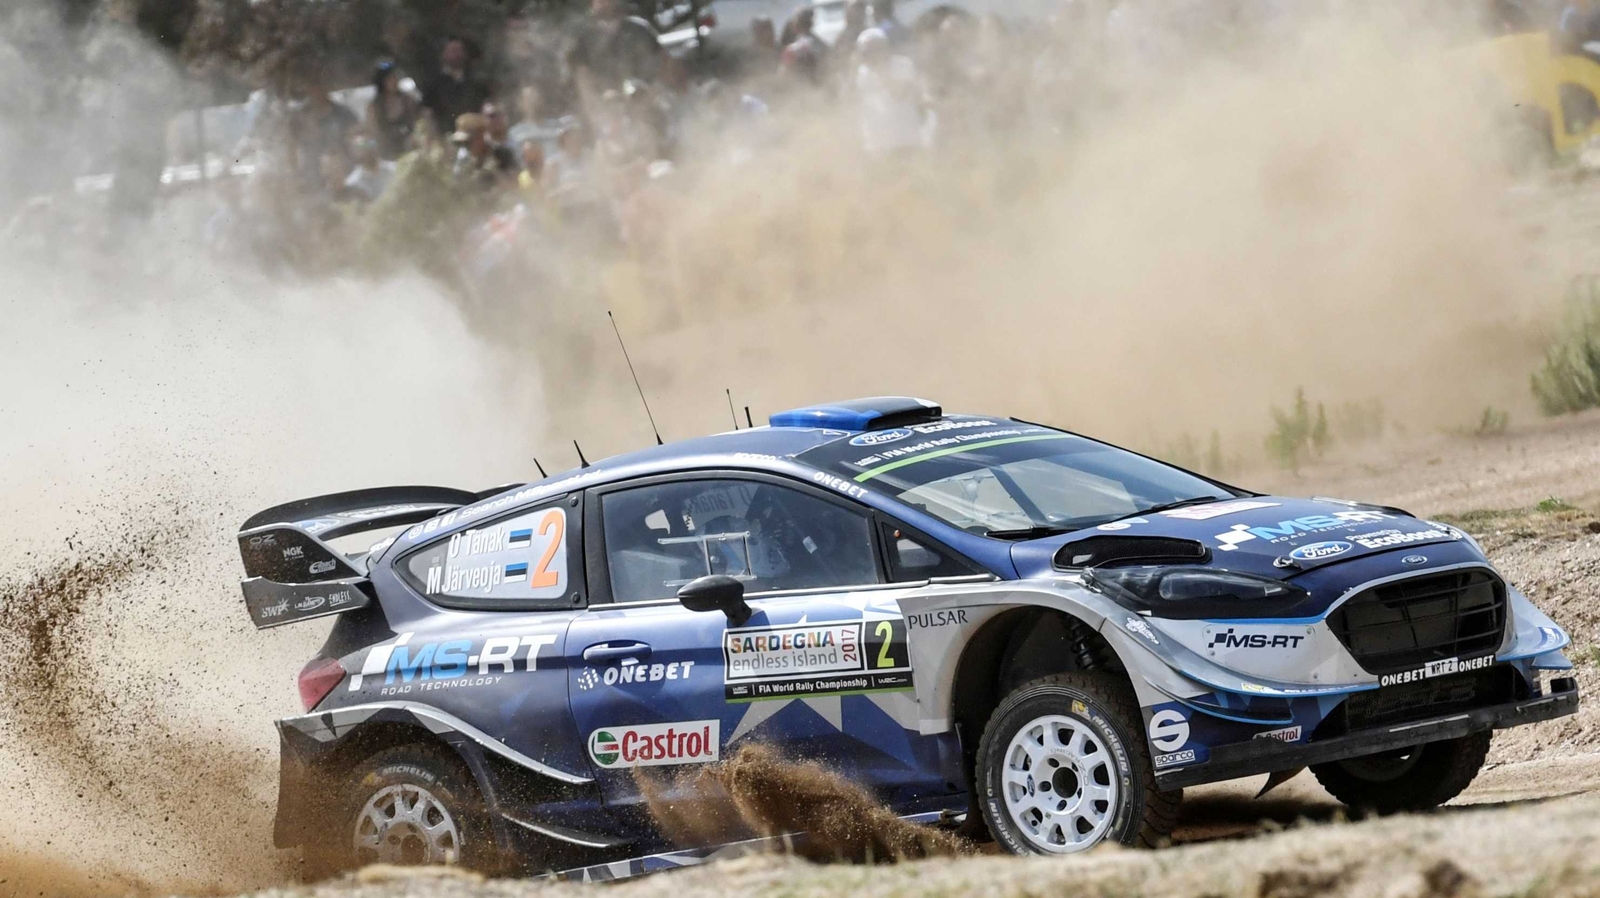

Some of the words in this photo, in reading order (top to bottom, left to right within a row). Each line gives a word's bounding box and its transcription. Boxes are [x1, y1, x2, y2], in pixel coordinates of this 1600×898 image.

[862, 431, 905, 444] Ford
[813, 471, 869, 498] ONEBET
[461, 495, 515, 518] Search
[449, 532, 462, 558] O
[465, 525, 505, 556] Tänak
[1270, 532, 1307, 544] ROAD
[1312, 519, 1384, 534] TECHNOLOGY
[282, 546, 304, 558] NGK
[531, 509, 565, 589] 2
[1301, 544, 1345, 558] Ford
[426, 566, 442, 595] M
[441, 561, 501, 593] Järveoja
[907, 609, 968, 630] PULSAR
[730, 630, 835, 655] SARDEGNA
[841, 628, 857, 662] 2017
[874, 620, 895, 668] 2
[1226, 634, 1305, 649] MS-RT
[386, 634, 558, 685] MS-RT
[732, 651, 789, 672] endless
[792, 648, 838, 668] island
[1459, 655, 1494, 672] ONEBET
[603, 660, 695, 687] ONEBET
[758, 683, 771, 694] FIA
[773, 681, 794, 693] World
[795, 681, 814, 693] Rally
[815, 677, 868, 690] Championship
[1381, 668, 1425, 687] ONEBET
[381, 685, 412, 697] ROAD
[420, 676, 503, 692] TECHNOLOGY
[622, 727, 714, 762] Castrol
[1092, 715, 1129, 772] MICHELIN
[1155, 750, 1194, 764] sparco
[382, 765, 435, 783] MICHELIN
